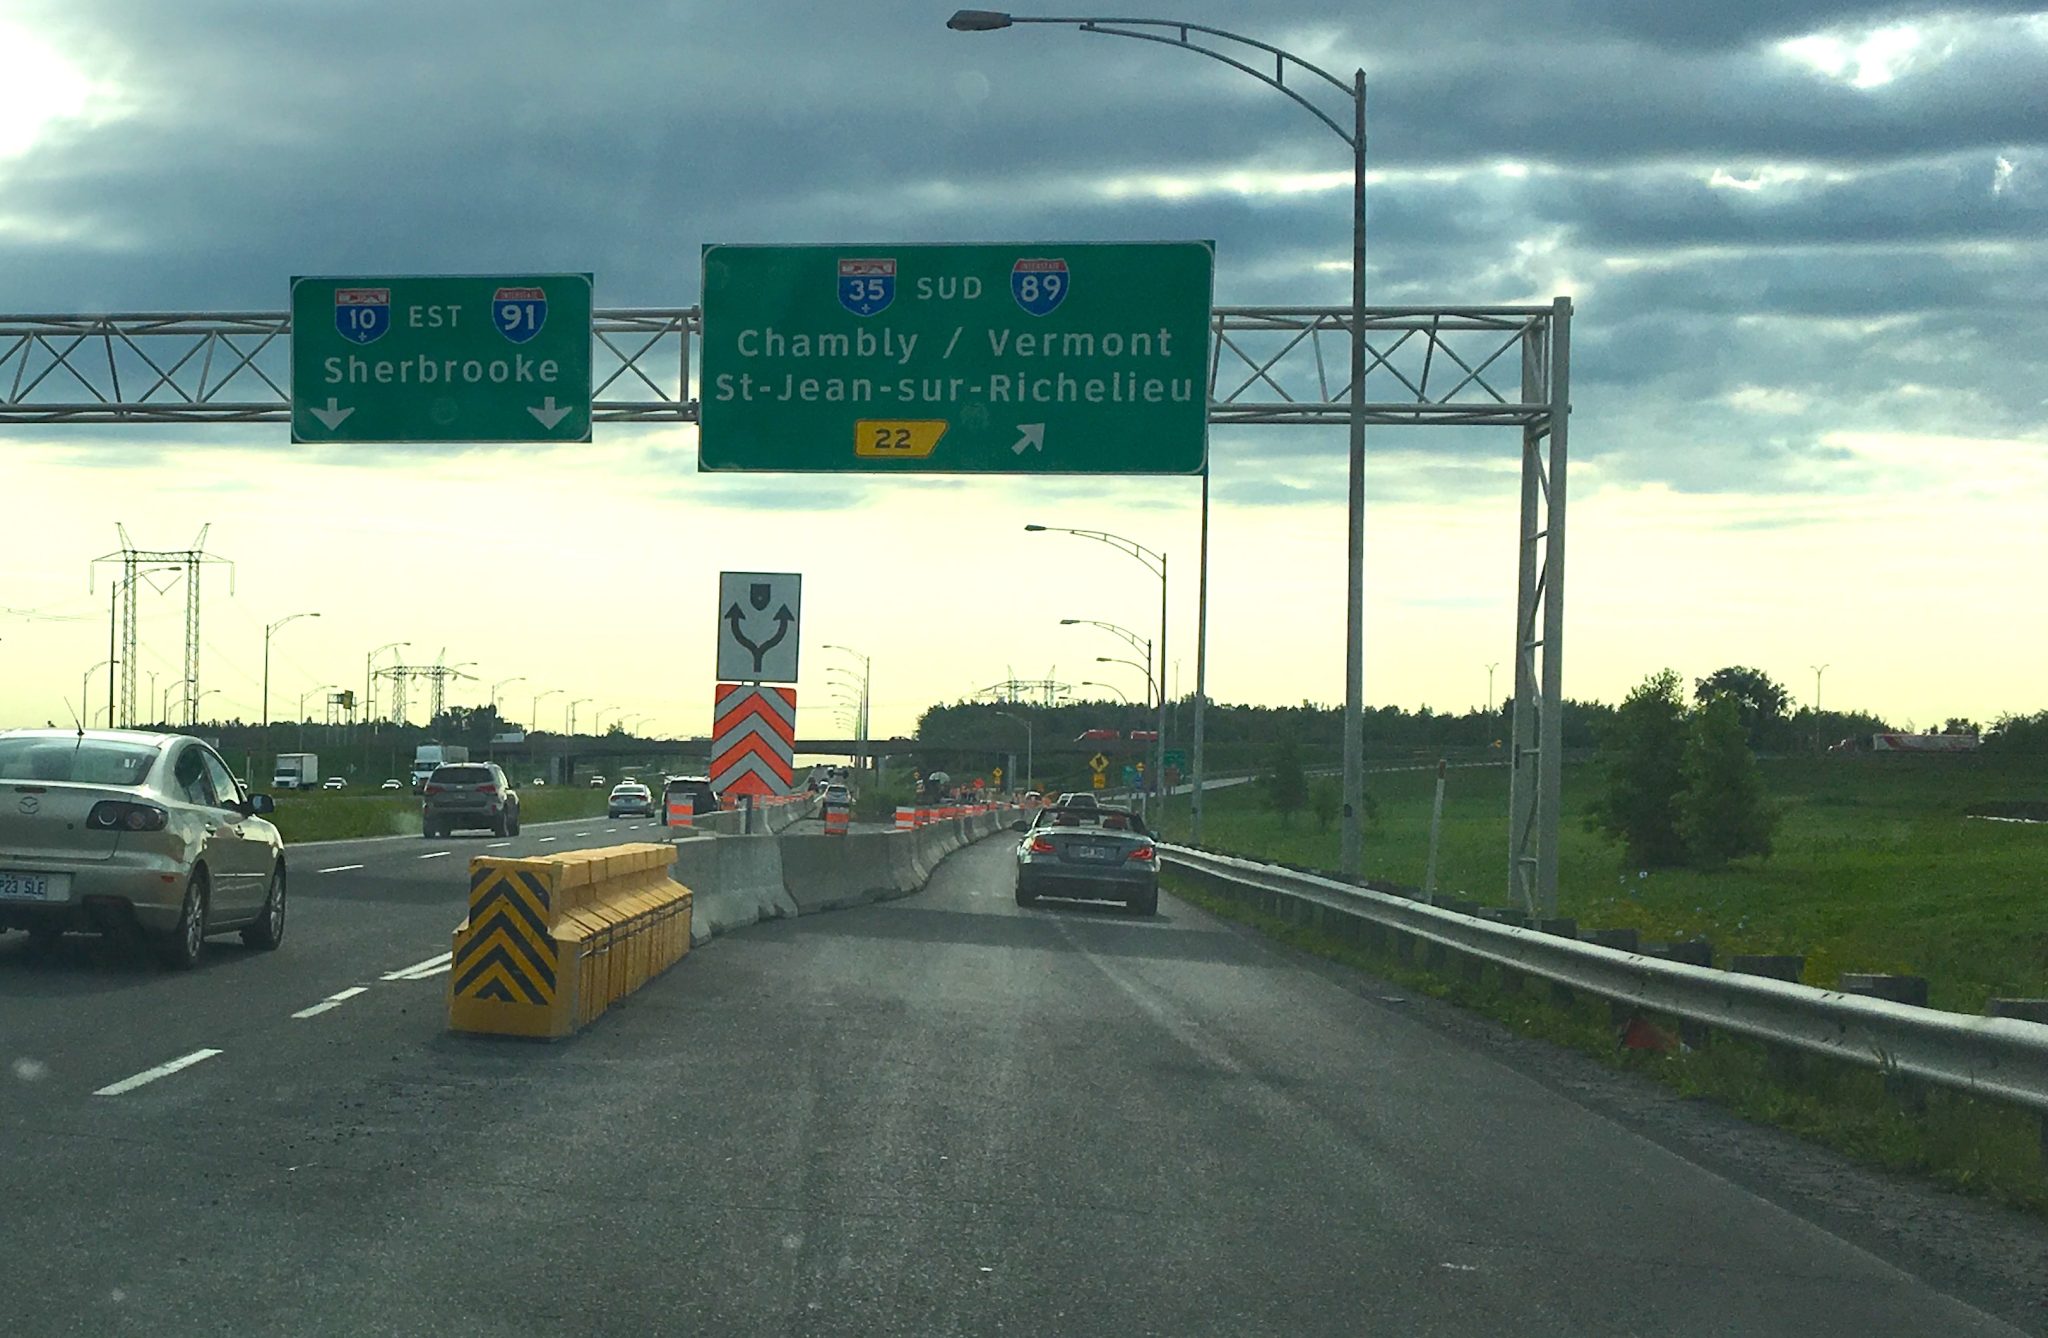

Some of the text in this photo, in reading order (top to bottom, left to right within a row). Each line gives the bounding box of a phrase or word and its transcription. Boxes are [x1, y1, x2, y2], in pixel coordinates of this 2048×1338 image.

[849, 275, 1061, 302] 35 SUD 89
[350, 304, 535, 331] 10 EST 91
[737, 326, 1172, 365] Chambly / Vermont
[325, 354, 559, 384] Sherbrooke
[716, 372, 1192, 402] St-Jean-sur-Richelieu
[875, 429, 911, 449] 22
[24, 880, 45, 895] SLE
